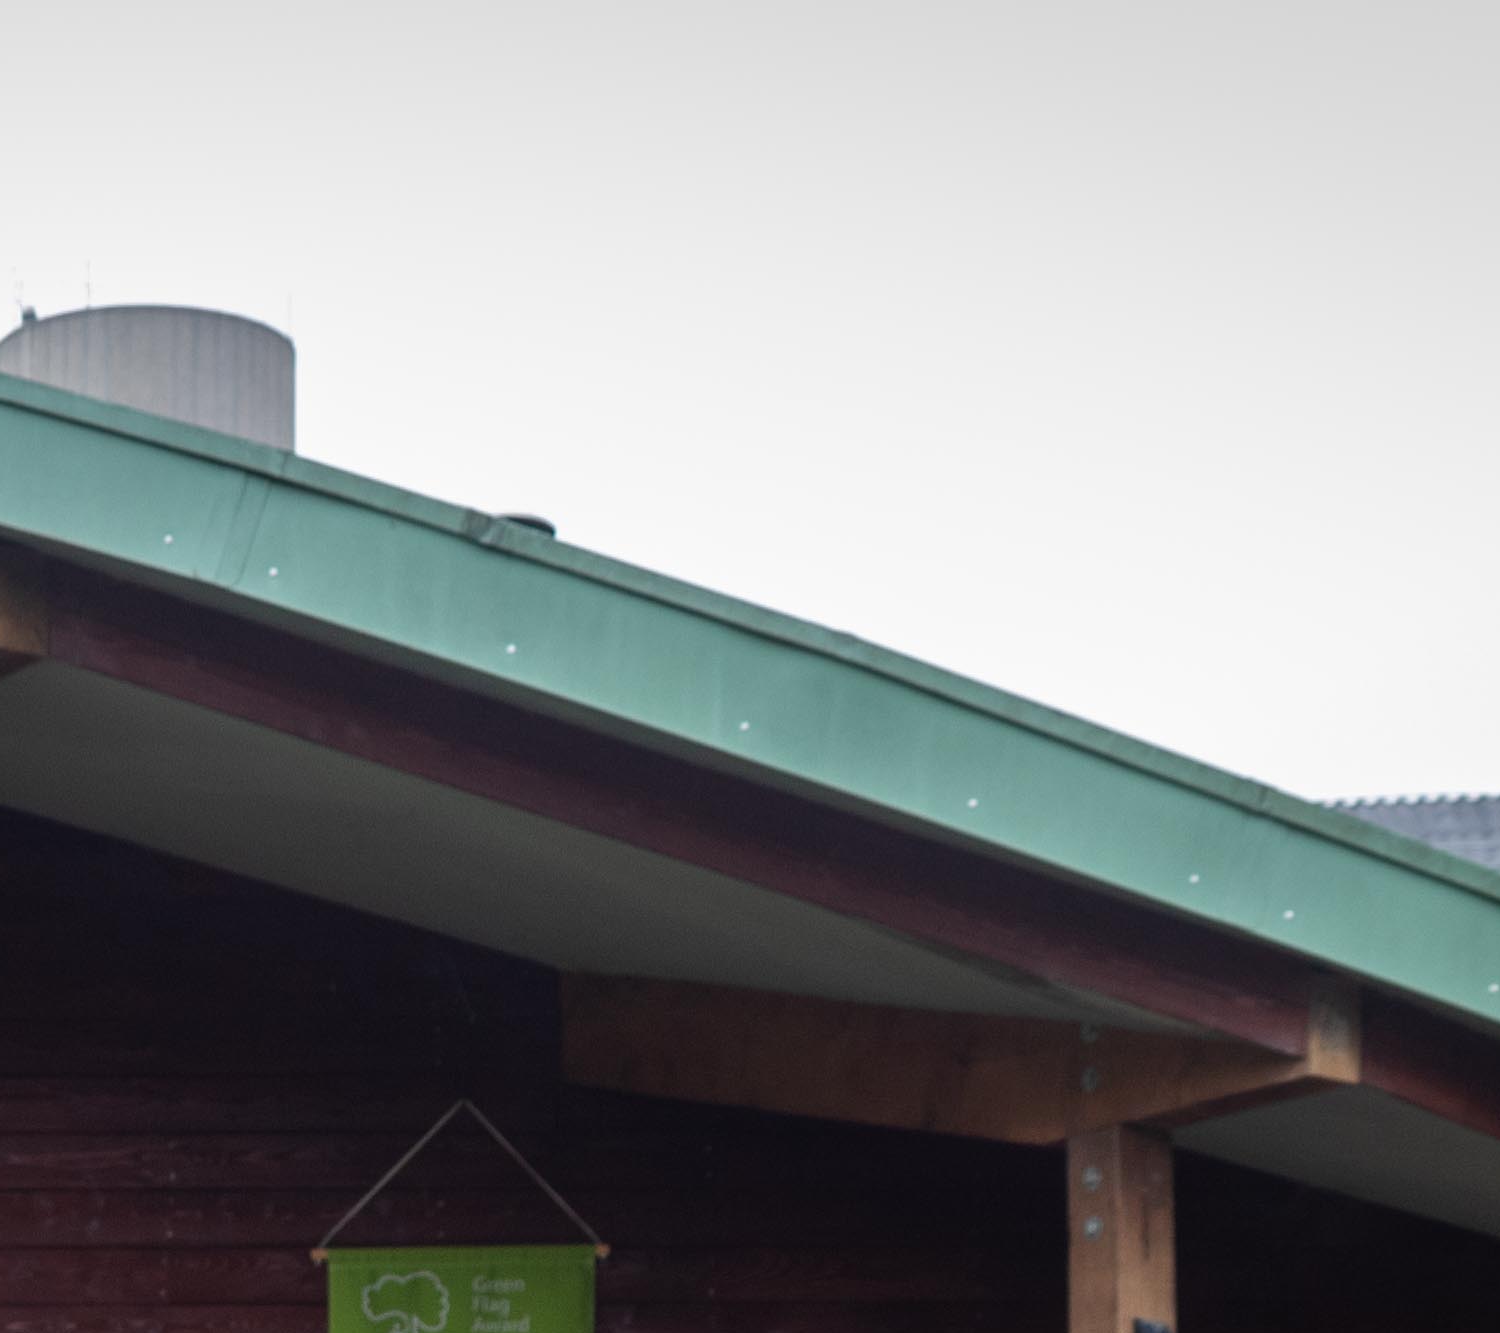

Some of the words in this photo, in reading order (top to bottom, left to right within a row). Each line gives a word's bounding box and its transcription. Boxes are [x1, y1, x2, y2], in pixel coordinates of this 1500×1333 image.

[471, 1275, 526, 1293] Green
[471, 1296, 511, 1317] Flag
[471, 1315, 530, 1333] Award
